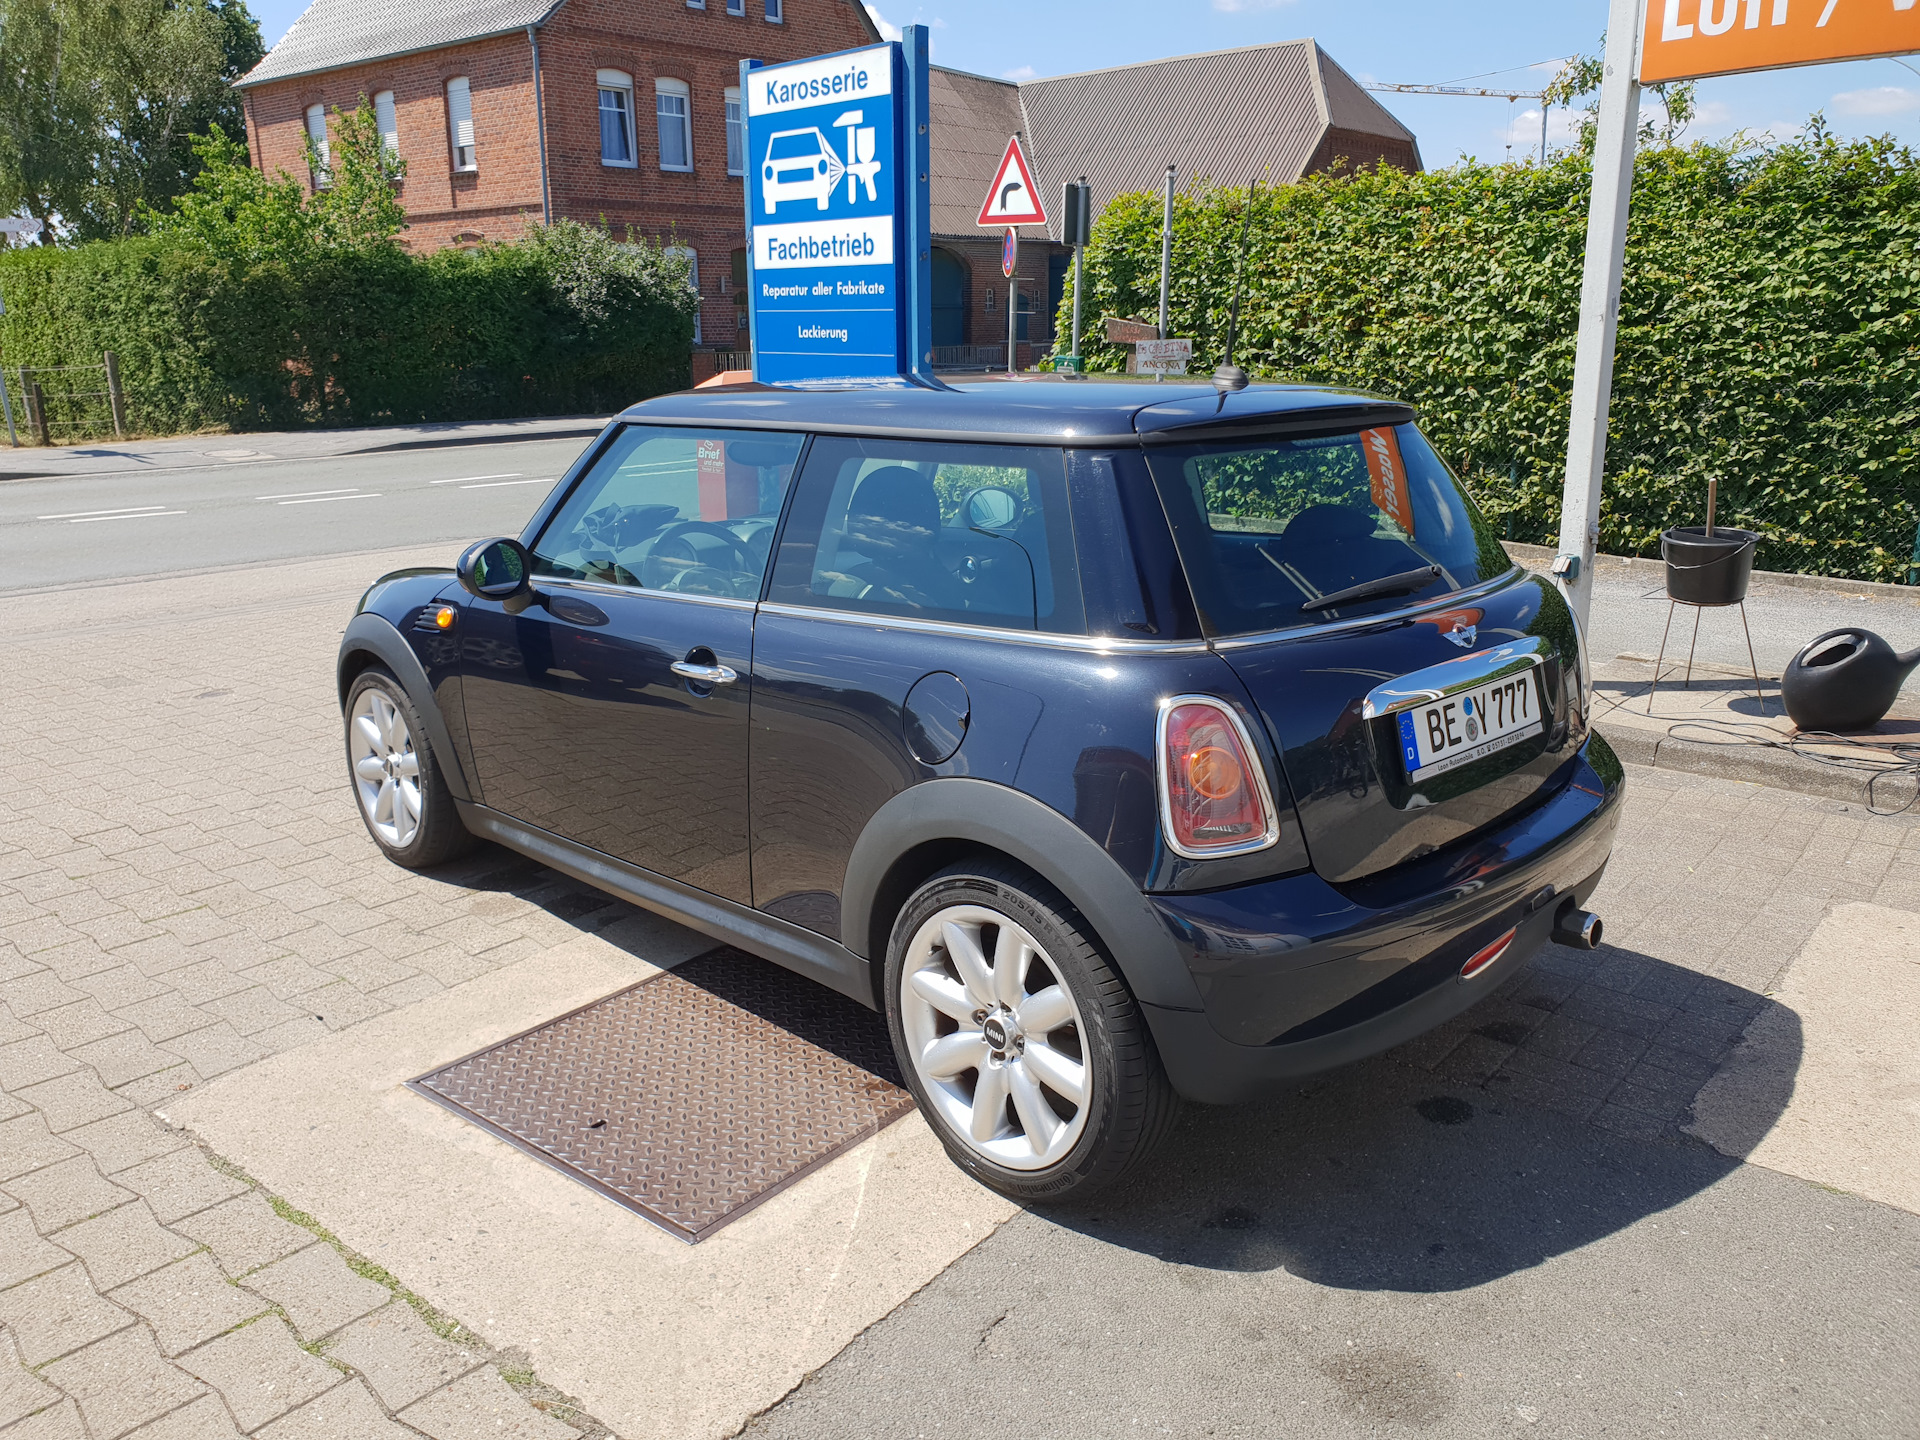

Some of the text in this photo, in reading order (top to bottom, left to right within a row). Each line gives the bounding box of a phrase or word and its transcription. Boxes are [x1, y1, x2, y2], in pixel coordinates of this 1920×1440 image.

[766, 65, 868, 106] Karosserie
[768, 232, 875, 261] Fachbetrieb
[762, 280, 885, 300] Reparatur aller Fabrikate
[797, 324, 848, 343] Lackierung
[1164, 341, 1190, 354] ETNA
[1142, 360, 1181, 370] ANCONA
[698, 447, 720, 460] Brief
[1426, 677, 1528, 754] BE Y 777
[1407, 746, 1415, 760] D
[1002, 890, 1043, 925] 205/45
[986, 1026, 1004, 1043] MINI
